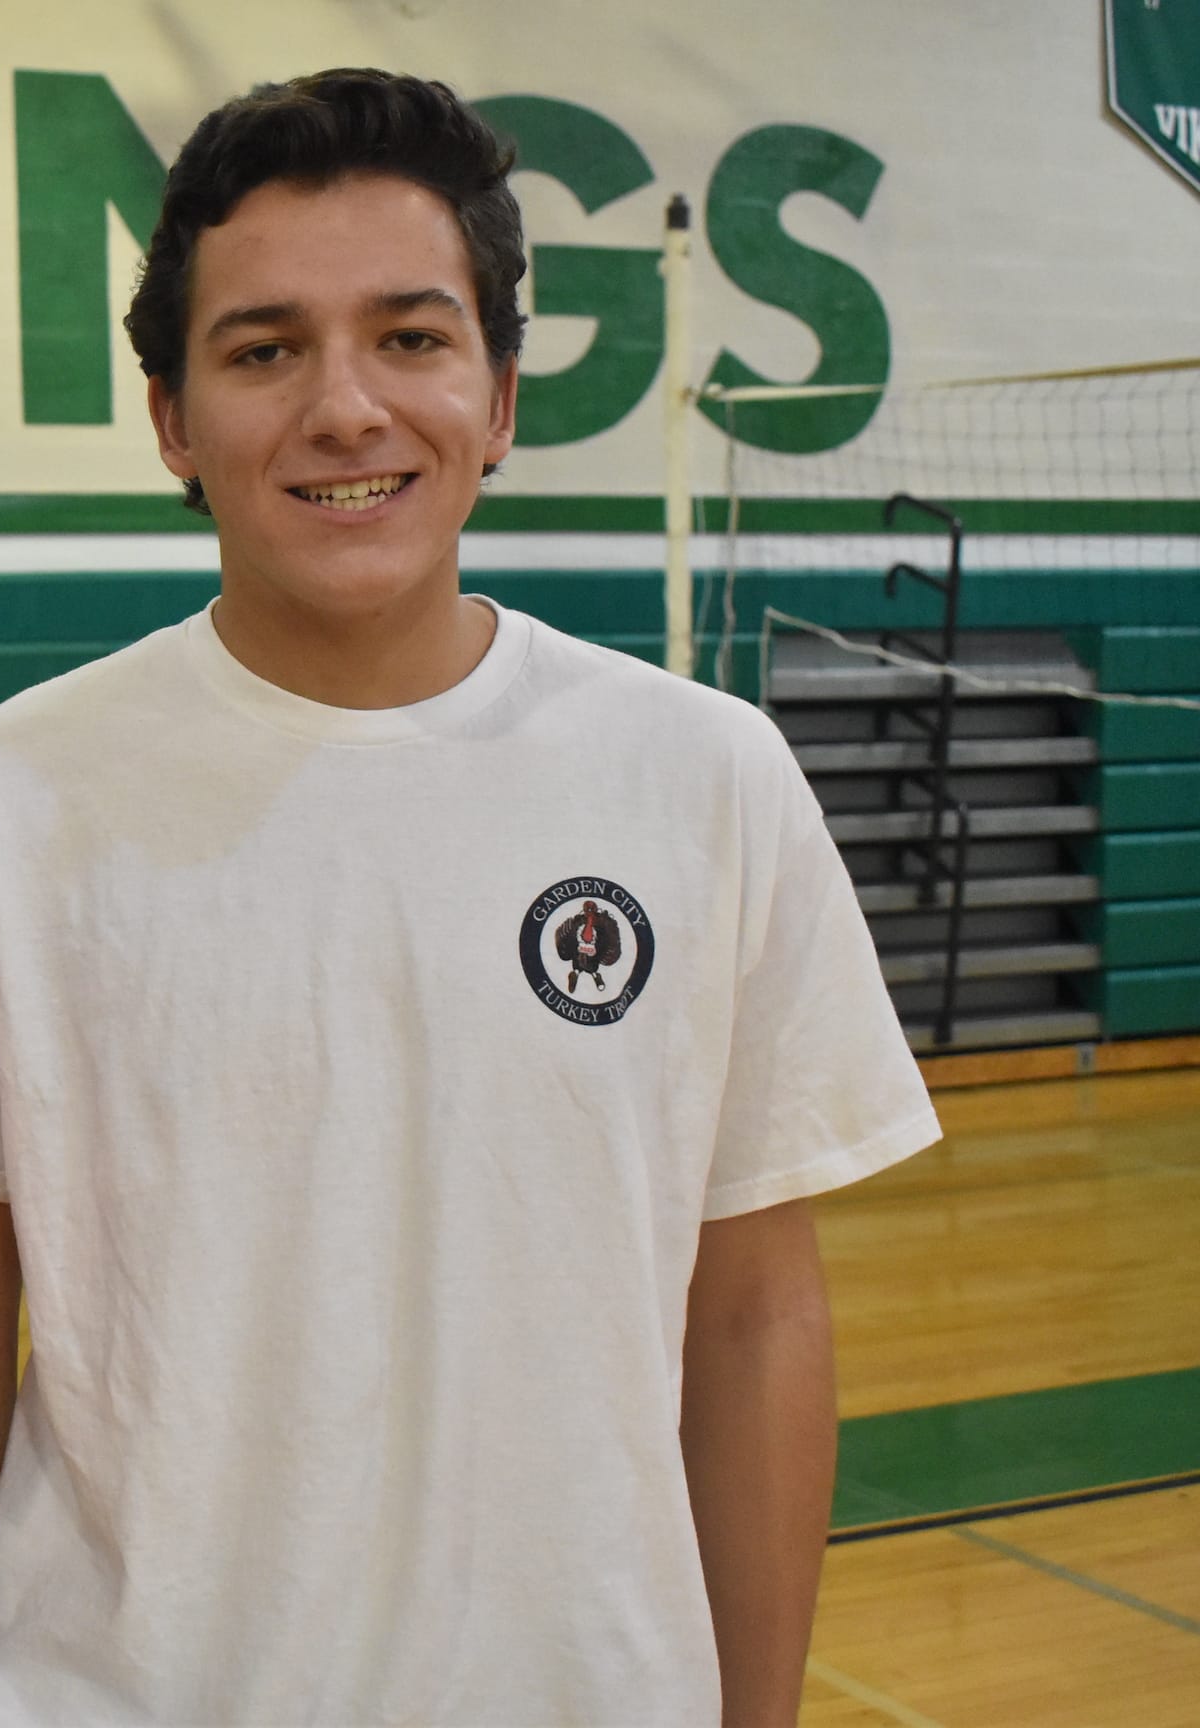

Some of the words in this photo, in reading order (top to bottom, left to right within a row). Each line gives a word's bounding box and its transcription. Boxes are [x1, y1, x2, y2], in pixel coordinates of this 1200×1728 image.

[532, 880, 607, 922] GARDEN
[611, 888, 647, 929] CITY
[538, 980, 600, 1023] TURKEY
[604, 985, 634, 1020] TROT
